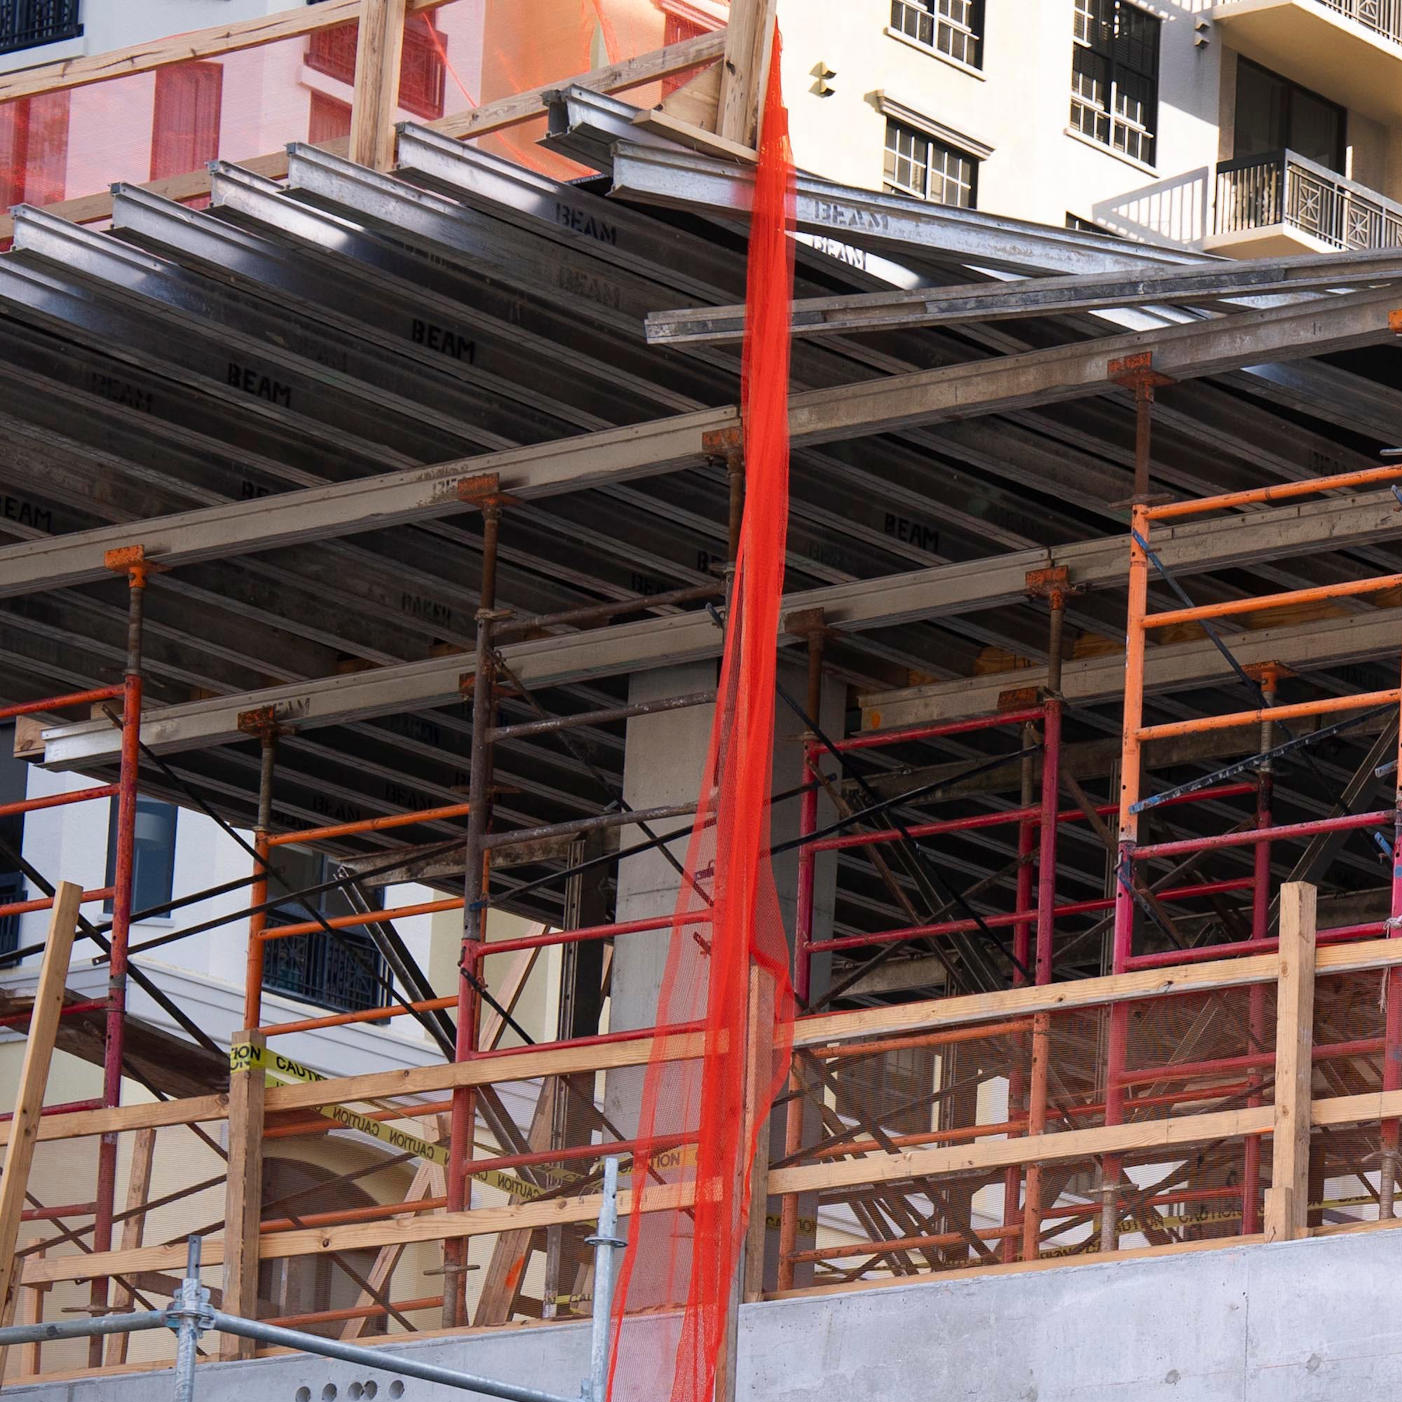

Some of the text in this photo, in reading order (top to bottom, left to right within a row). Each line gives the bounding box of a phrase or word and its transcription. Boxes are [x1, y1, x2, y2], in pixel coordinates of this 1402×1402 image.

[556, 202, 616, 247] BEAM
[814, 200, 889, 231] BEAM
[812, 235, 867, 271] BEAM
[411, 318, 476, 364] BEAM
[228, 363, 291, 408] BEAM
[0, 496, 52, 533] EAM
[885, 513, 939, 551] BEAM
